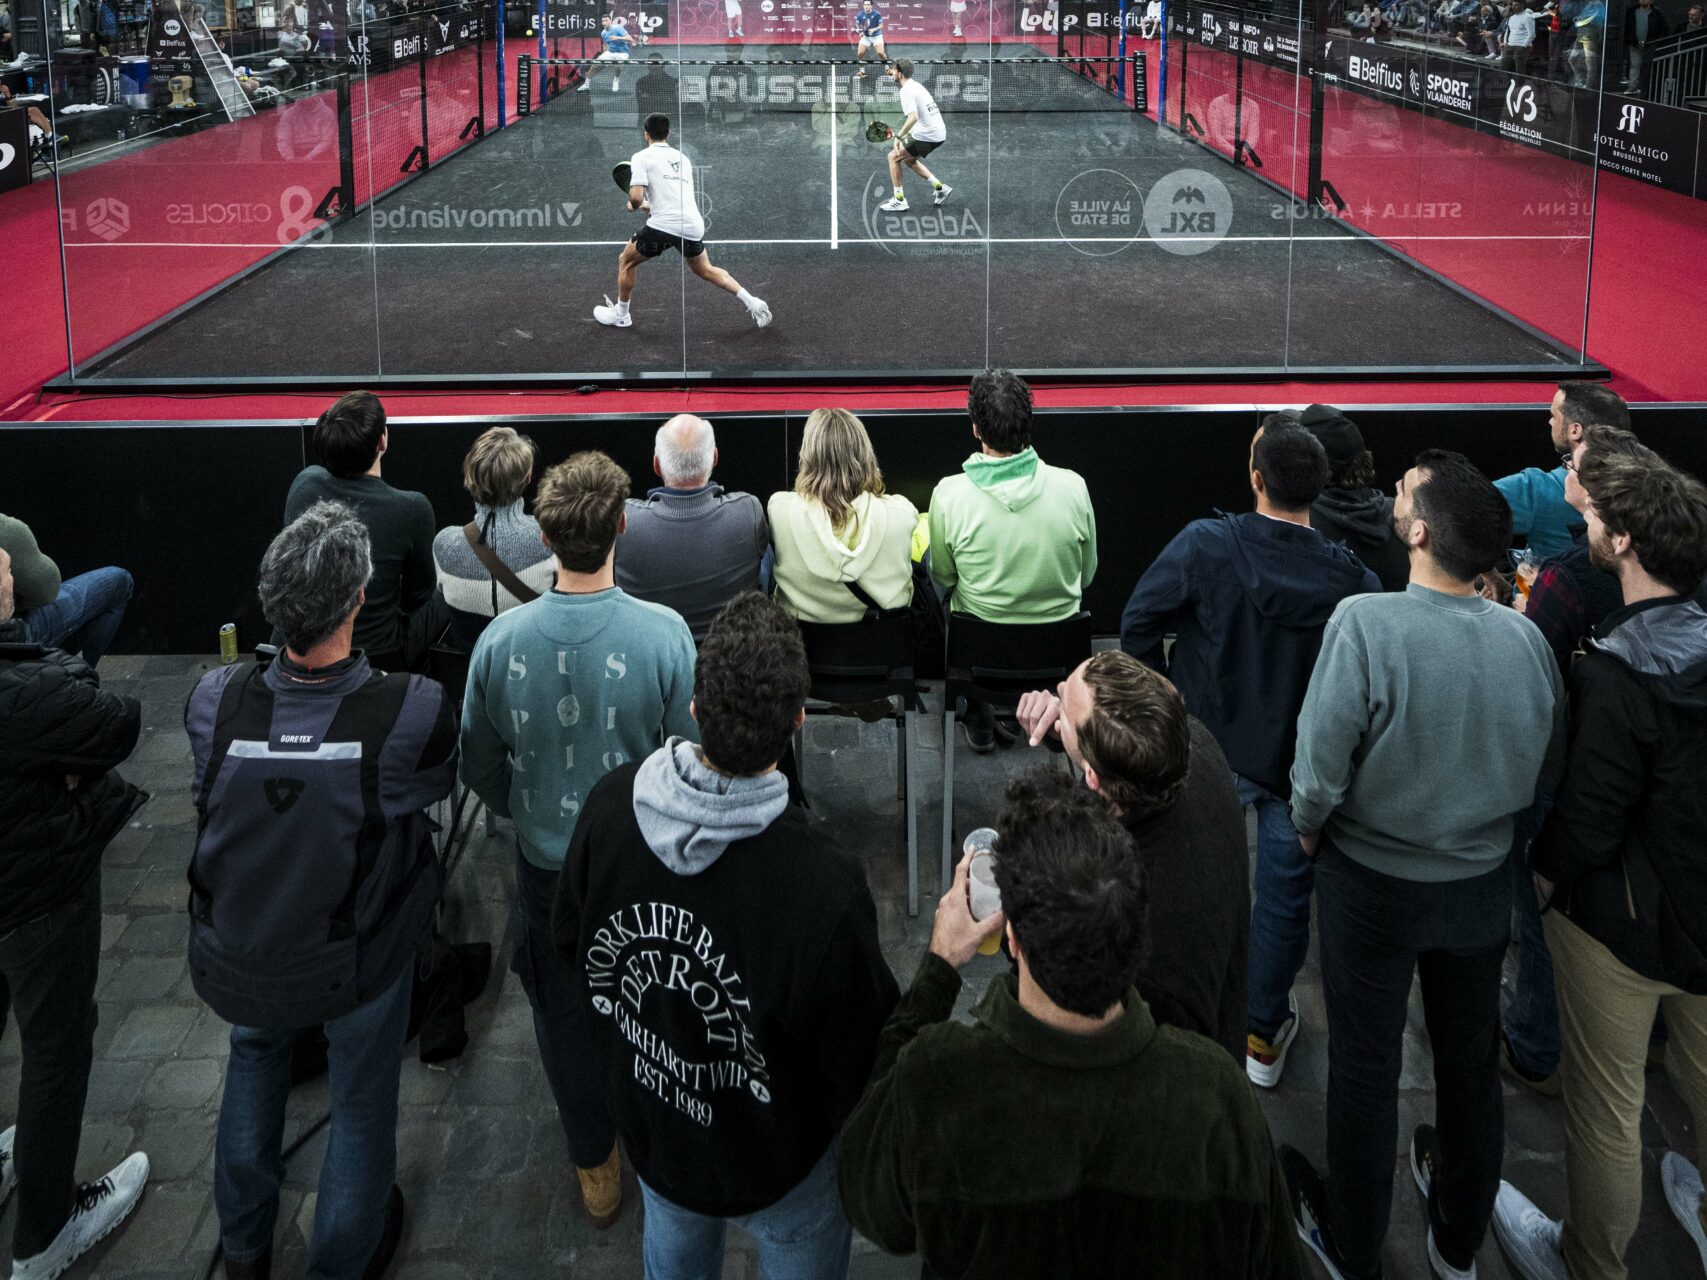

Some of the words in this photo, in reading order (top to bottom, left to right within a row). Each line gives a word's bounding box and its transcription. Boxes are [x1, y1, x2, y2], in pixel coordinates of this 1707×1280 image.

[1202, 13, 1215, 30] RTL
[166, 39, 186, 47] Belfius
[403, 34, 428, 57] Belfis
[1201, 31, 1215, 45] play
[1228, 35, 1239, 50] LE
[1361, 58, 1403, 91] Belfius
[681, 75, 900, 103] BRUSSELS
[934, 74, 990, 102] P2
[1426, 90, 1472, 112] VLAANDEREN
[1499, 120, 1542, 139] FÉDÉRATION
[1612, 150, 1643, 164] BRUSSELS
[1629, 143, 1669, 162] AMIGO
[1621, 165, 1641, 177] FORTE
[1642, 171, 1663, 184] HOTEL
[585, 909, 639, 989] WORK
[631, 902, 694, 946] LIFE
[621, 950, 737, 1052] DETROIT
[614, 1000, 707, 1091] CARHARTT
[709, 1059, 748, 1092] WIP
[634, 1053, 670, 1103] EST.
[674, 1085, 713, 1128] 1989
